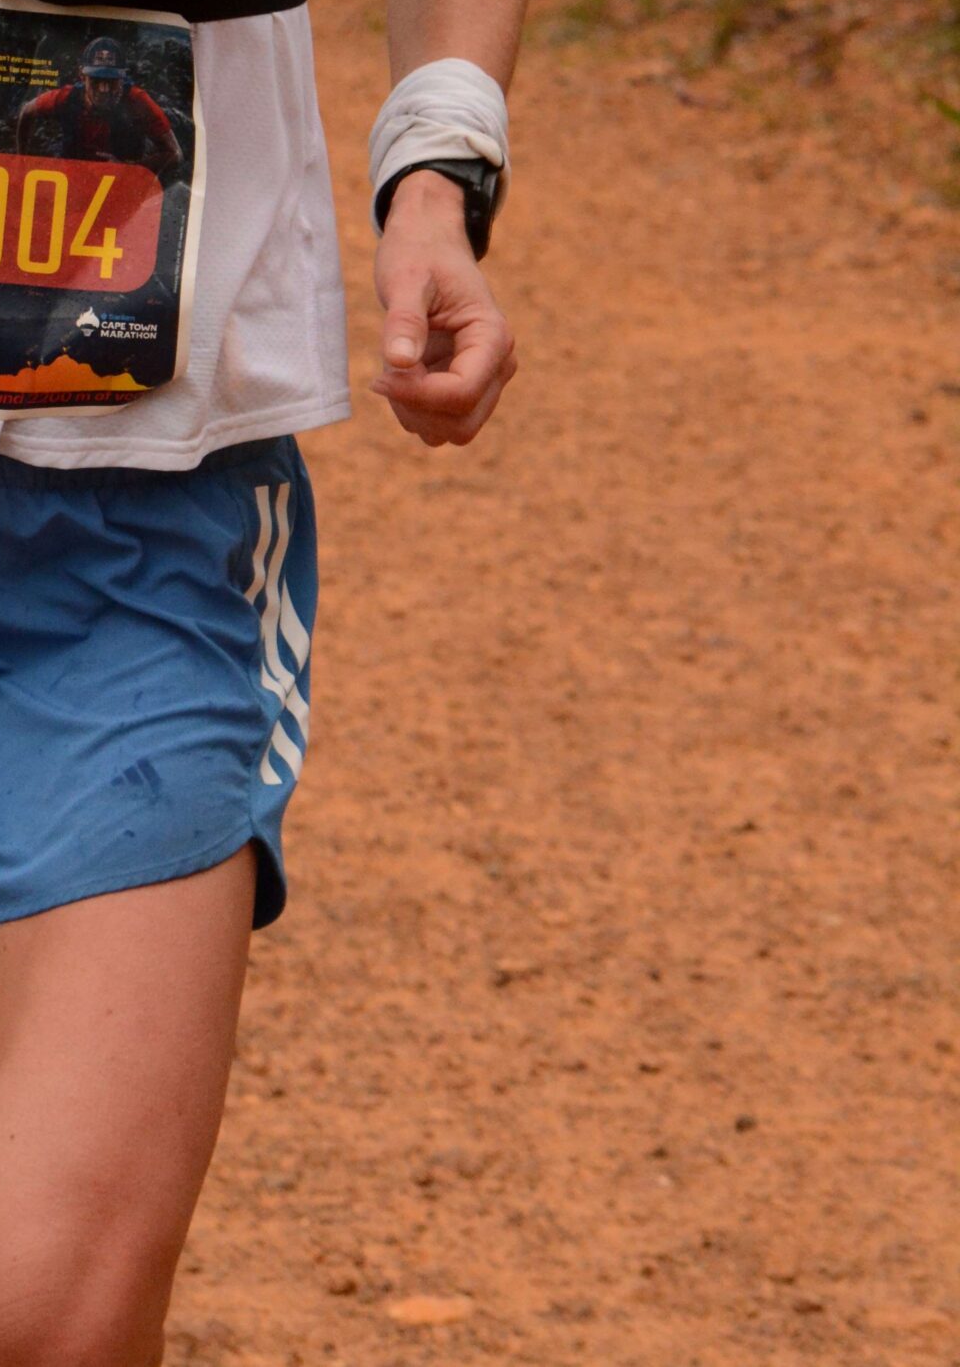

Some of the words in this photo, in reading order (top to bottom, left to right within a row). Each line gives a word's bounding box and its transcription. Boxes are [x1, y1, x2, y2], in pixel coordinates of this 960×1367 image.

[101, 321, 126, 331] CAPE
[129, 323, 158, 332] TOWN
[100, 330, 157, 340] MARATHON
